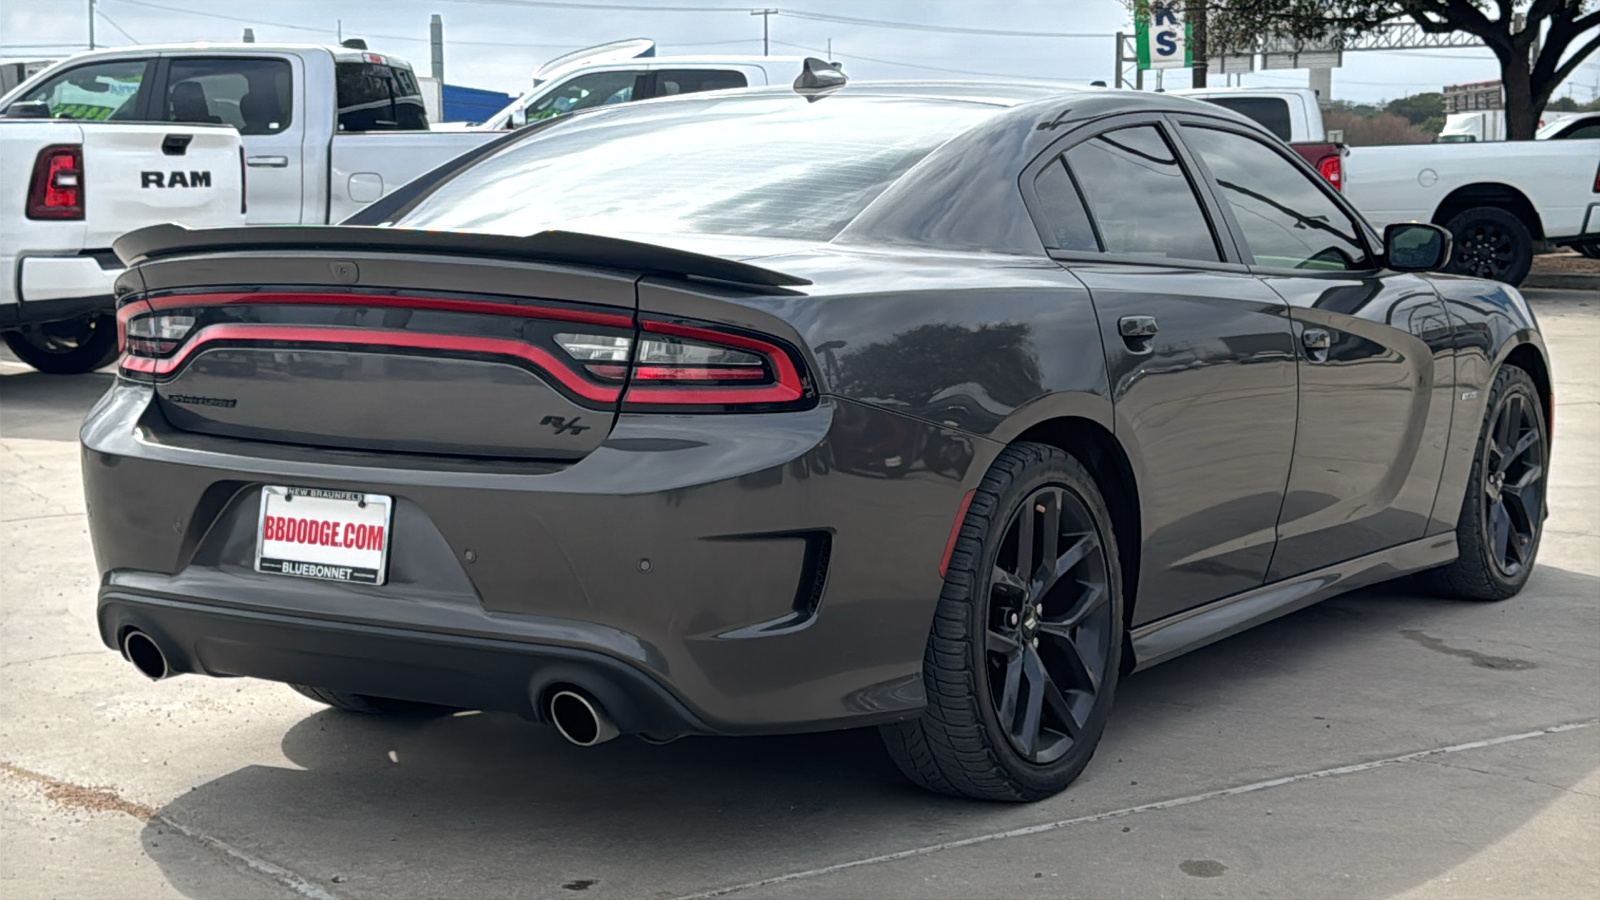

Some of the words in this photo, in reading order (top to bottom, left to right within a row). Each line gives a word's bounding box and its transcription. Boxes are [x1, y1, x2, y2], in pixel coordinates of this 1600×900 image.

[140, 170, 212, 188] RAM
[540, 415, 591, 435] R/T
[288, 488, 309, 496] NEW
[311, 490, 363, 501] BRAUNFELS
[264, 515, 384, 551] BBDODGE.COM
[281, 561, 353, 580] BLUEBONNET
